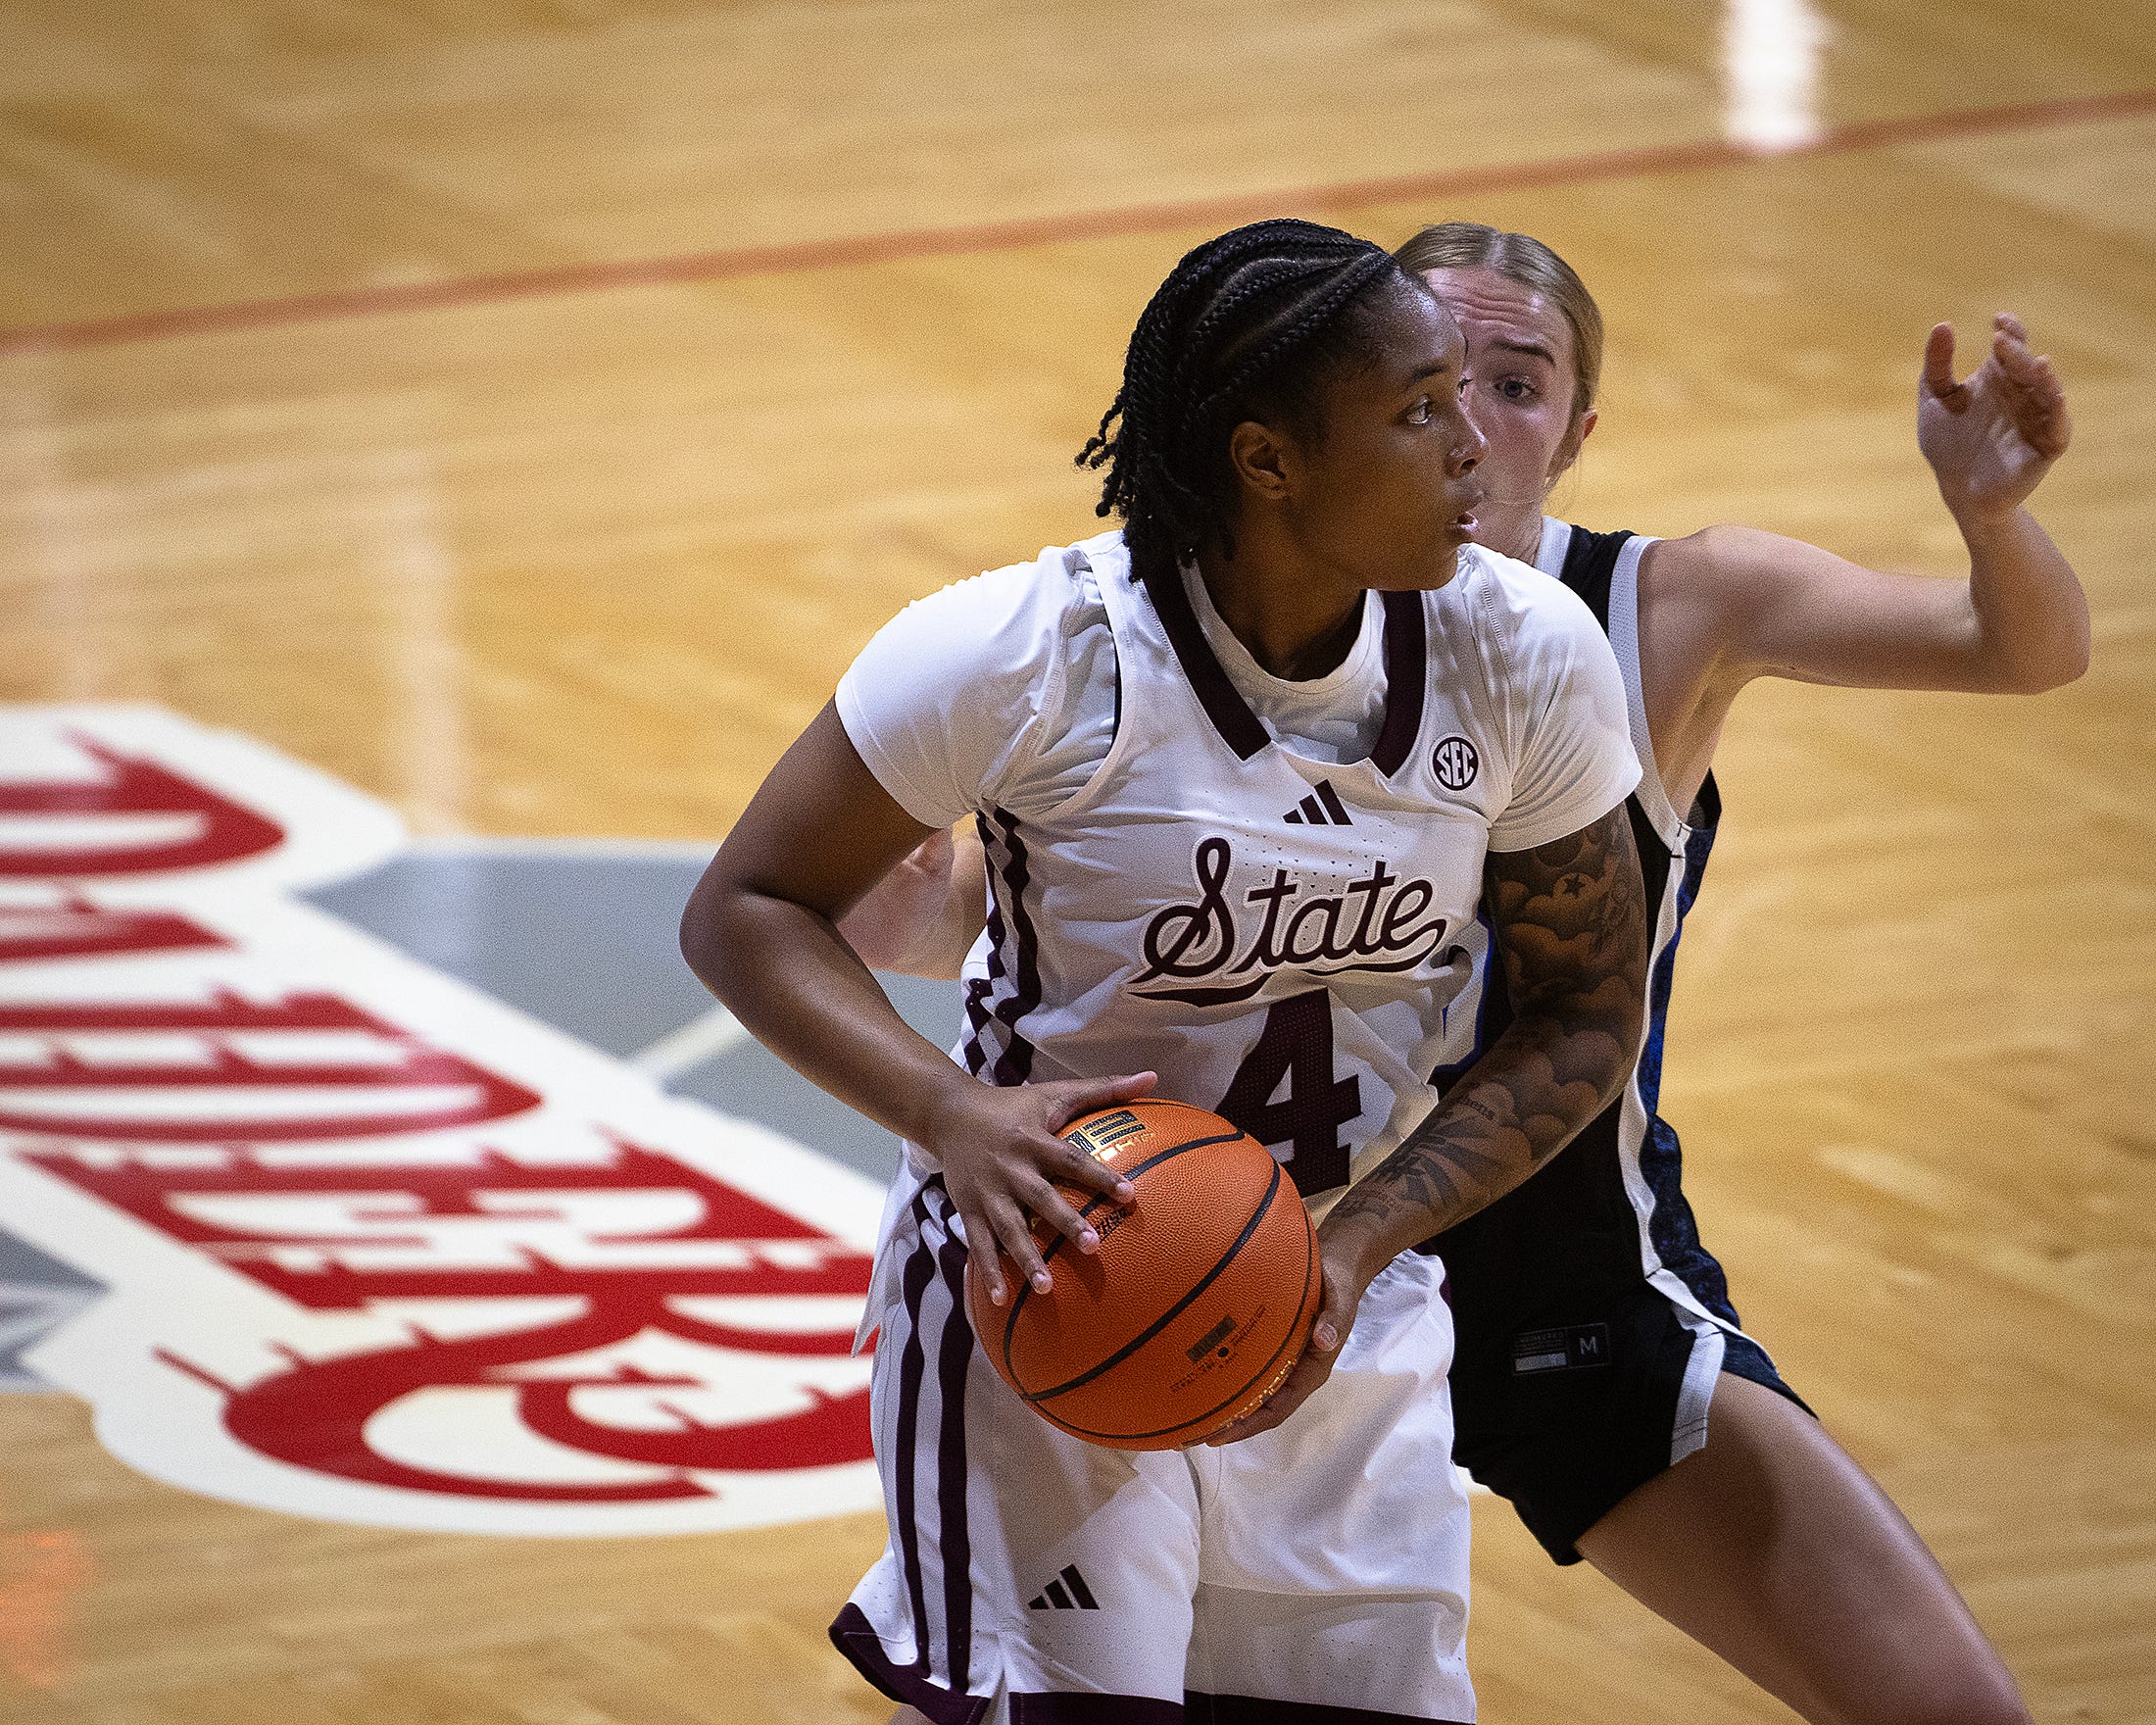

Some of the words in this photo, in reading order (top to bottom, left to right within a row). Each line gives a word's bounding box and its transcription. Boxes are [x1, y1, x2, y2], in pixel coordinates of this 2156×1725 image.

[1436, 741, 1475, 787] SEC
[1126, 835, 1448, 990] State
[1213, 986, 1363, 1200] 4
[1579, 1336, 1598, 1355] M
